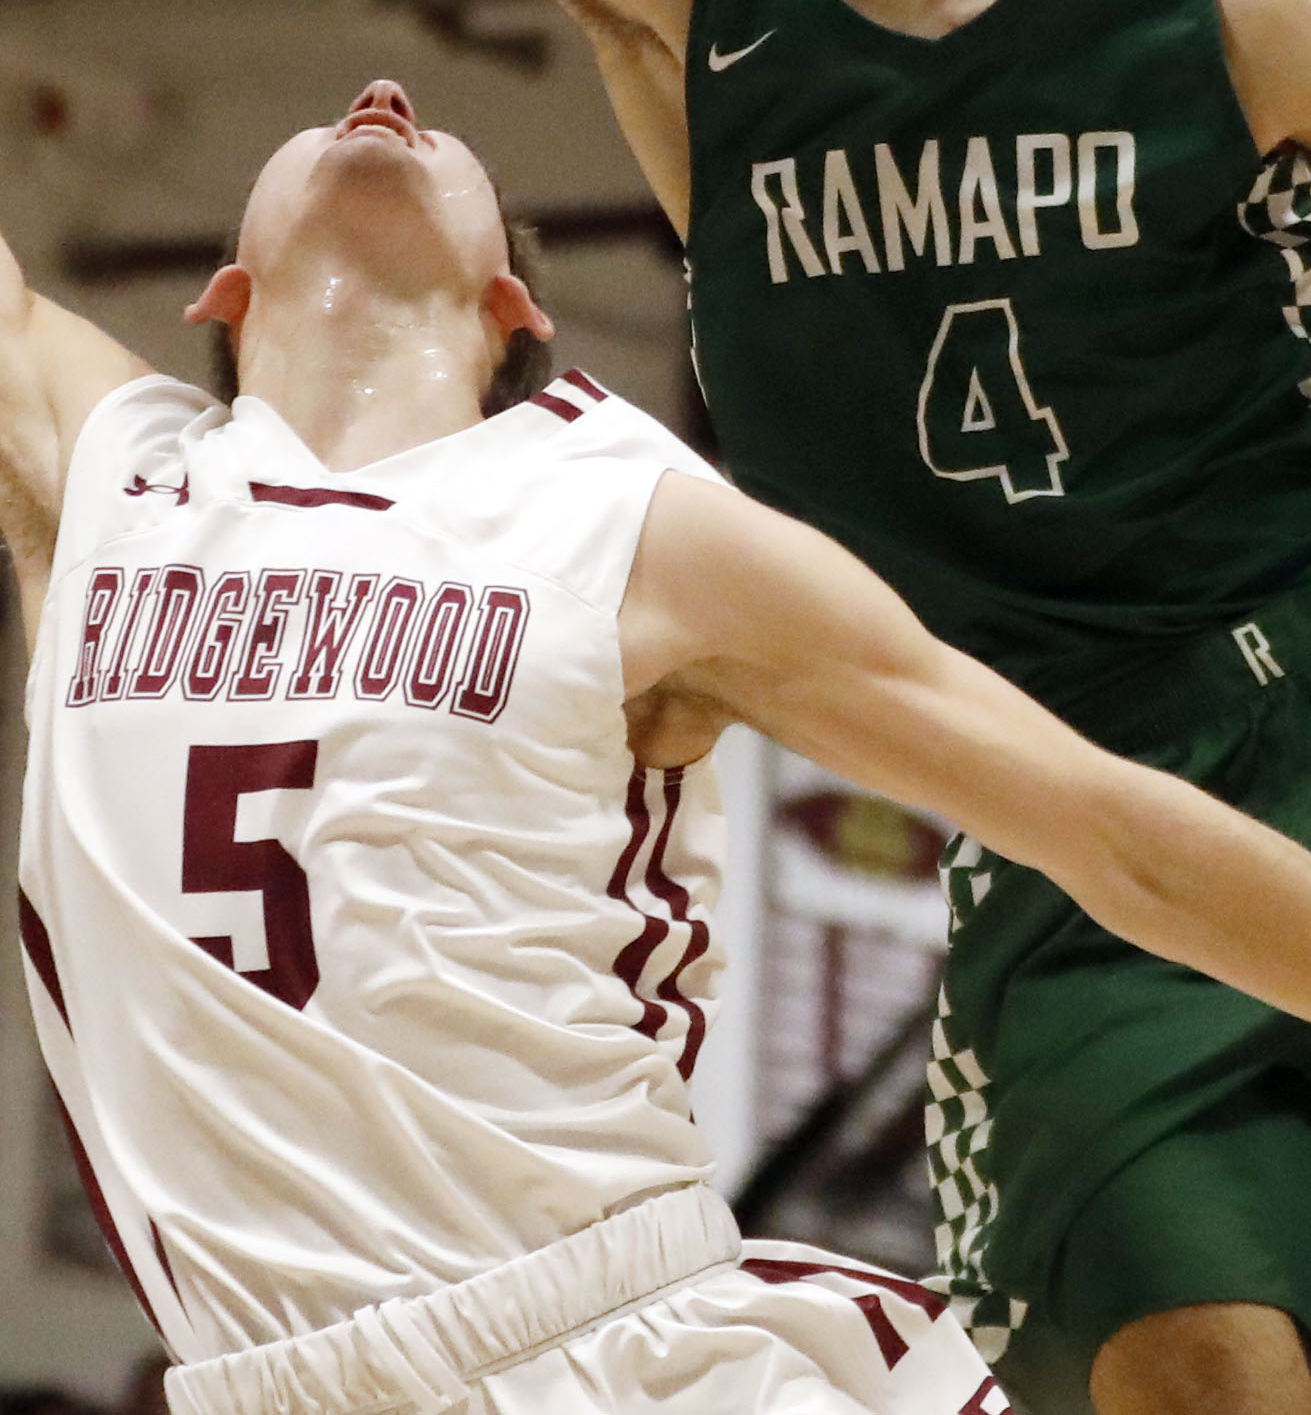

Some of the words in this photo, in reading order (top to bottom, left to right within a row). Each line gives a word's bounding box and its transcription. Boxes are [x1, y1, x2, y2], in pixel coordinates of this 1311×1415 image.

[751, 131, 1139, 283] RAMAPO
[916, 298, 1070, 504] 4
[65, 564, 530, 723] RIDGEWOOD
[1231, 622, 1285, 686] R
[181, 739, 321, 1012] 5
